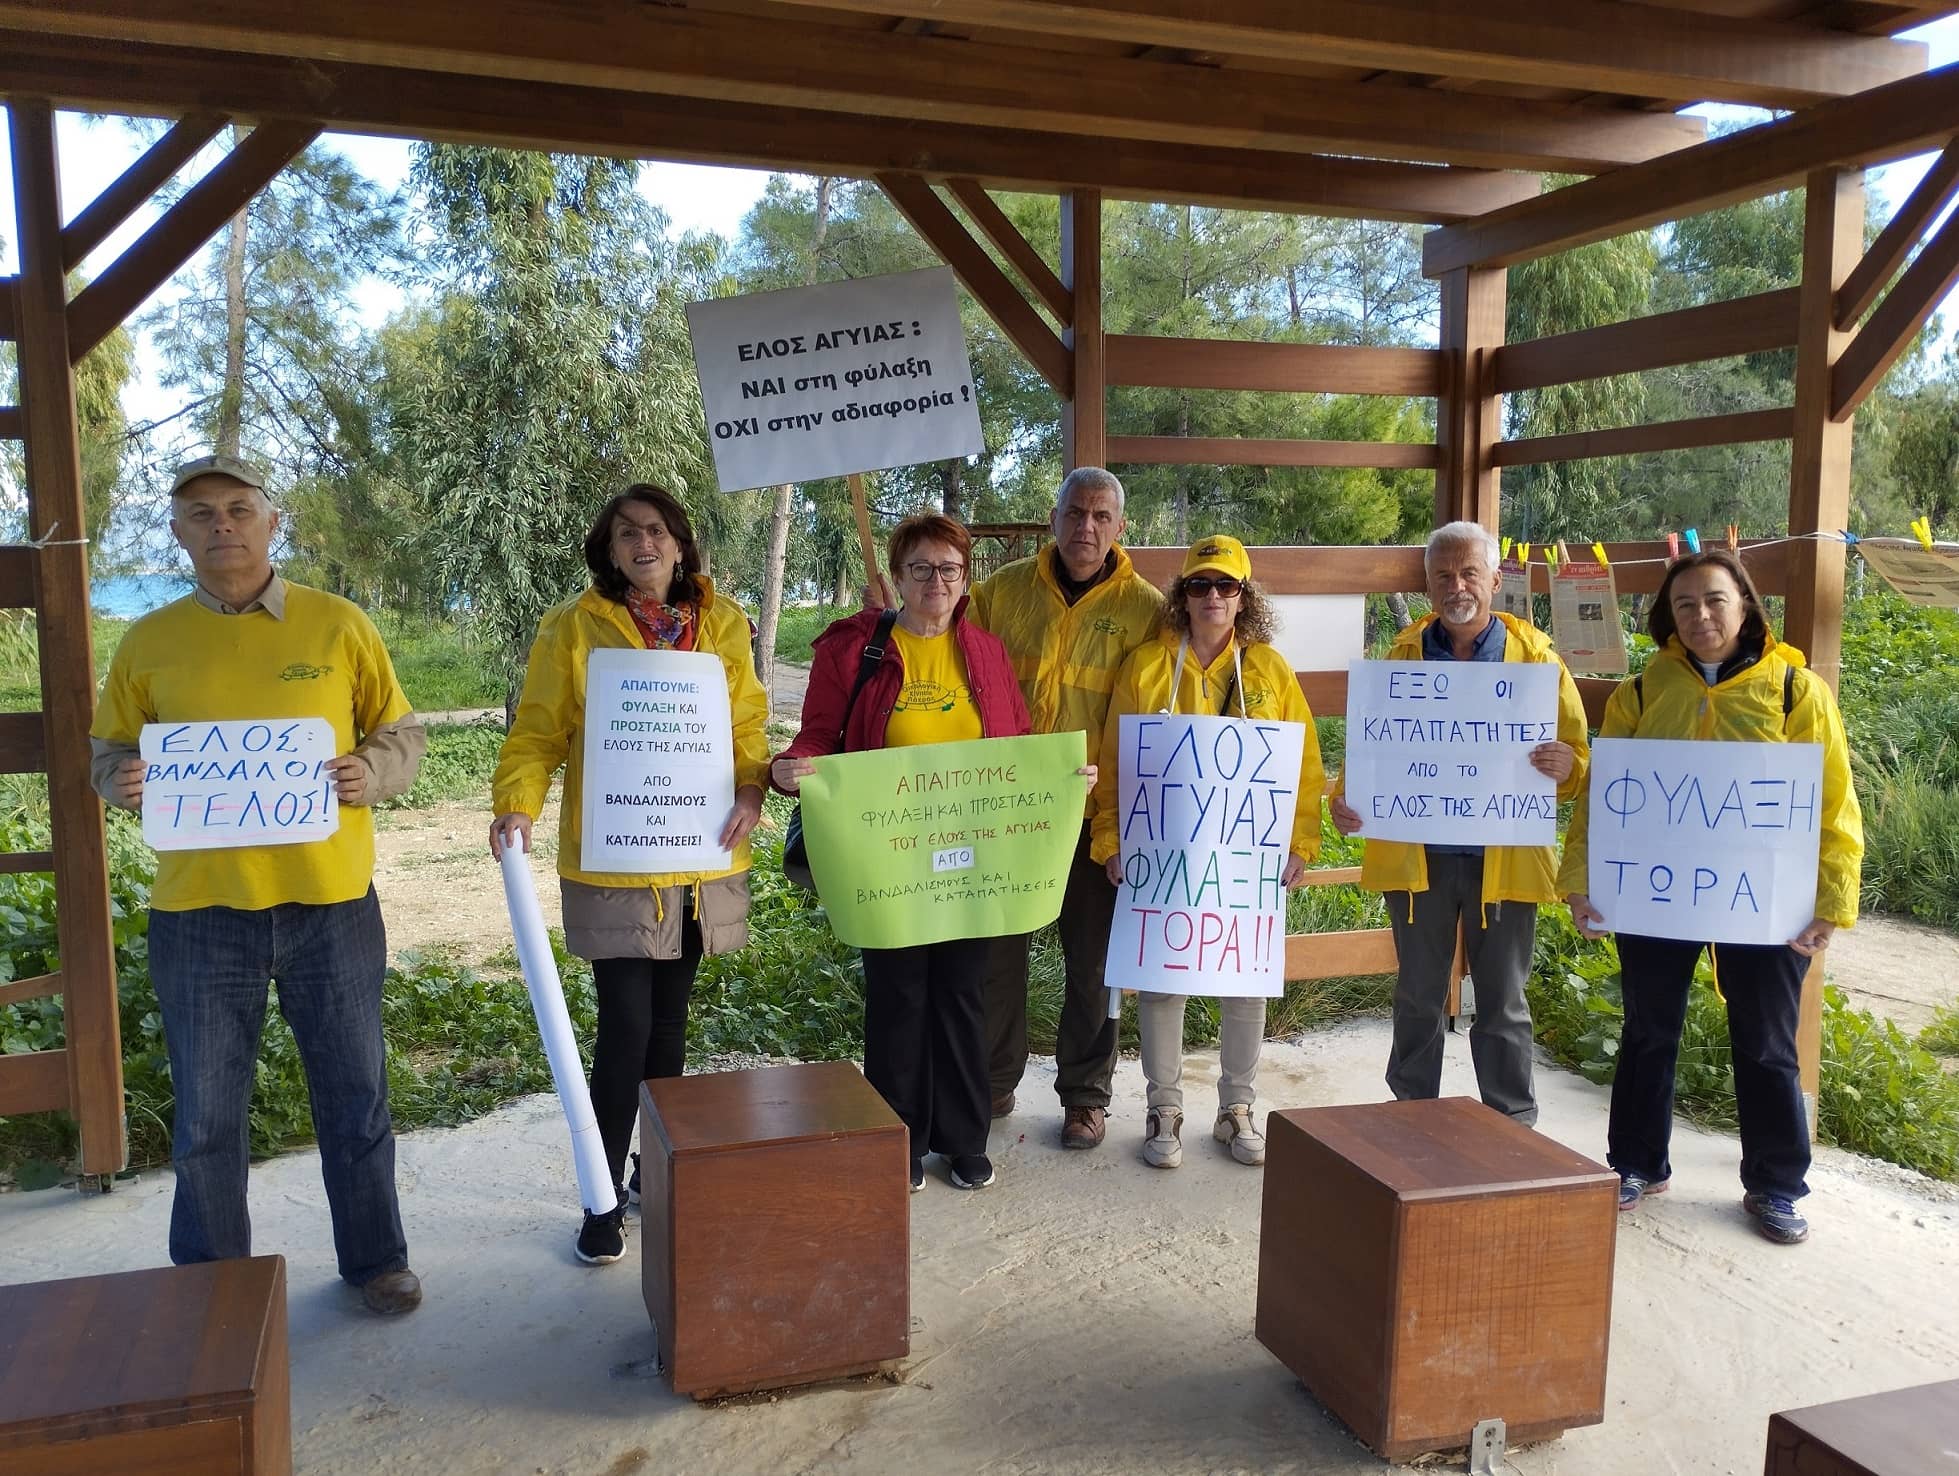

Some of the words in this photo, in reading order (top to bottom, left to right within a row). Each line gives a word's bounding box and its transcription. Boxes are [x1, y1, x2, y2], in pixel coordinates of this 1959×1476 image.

[738, 336, 807, 362] ΕΛΟΣ
[814, 321, 905, 351] ΑΓΥΙΑΣ
[741, 377, 786, 400] ΝΑΙ
[794, 372, 838, 392] στη
[844, 357, 932, 387] φύλαξη
[714, 417, 759, 439] ΟΧΙ
[767, 411, 823, 431] στην
[831, 390, 954, 422] αδιαφορία
[620, 679, 700, 694] ΑΠΑΙΤΟΥΜΕ:
[1389, 671, 1449, 700] ΕΞΩ
[1495, 680, 1513, 699] ΟΙ
[621, 701, 676, 713] ΦΥΛΑΞΗ
[679, 703, 697, 714] ΚΑΙ
[610, 720, 681, 733] ΠΡΟΣΤΑΣΙΑ
[684, 722, 707, 734] ΤΟΥ
[1364, 717, 1555, 743] ΚΑΤΑΠΑΤΗΤΕΣ
[604, 739, 644, 752] ΕΛΟΥΣ
[647, 741, 670, 753] ΤΗΣ
[673, 742, 712, 754] ΑΓΥΙΑΣ
[1136, 721, 1281, 785] ΕΛΟΣ
[145, 759, 323, 783] ΒΑΝΔΑΛΟΙ
[643, 775, 672, 787] ΑΠΟ
[896, 764, 1017, 796] ΑΠΑΙΤΟΥΜΕ
[1407, 762, 1438, 778] ΑΠΟ
[1456, 765, 1477, 777] ΤΟ
[163, 781, 330, 828] ΤΕΛΟΣ!
[605, 793, 707, 806] ΒΑΝΔΑΛΙΣΜΟΥΣ
[861, 805, 933, 829] ΦΥΛΑΞΗ
[938, 802, 963, 820] ΚΑΙ
[970, 791, 1055, 815] ΠΡΟΣΤΑΣΙΑ
[1372, 794, 1434, 819] ΕΛΟΣ
[1439, 796, 1475, 817] ΤΗΣ
[1604, 768, 1815, 833] ΦΥΛΑΞΗ
[646, 815, 666, 826] ΚΑΙ
[1124, 781, 1292, 848] ΑΓΥΙΑΣ
[606, 834, 702, 847] ΚΑΤΑΠΑΤΗΣΕΙΣ!
[889, 834, 918, 851] ΤΟΥ
[928, 830, 968, 846] ΕΛΟΥΣ
[972, 827, 997, 840] ΤΗΣ
[1005, 820, 1051, 836] ΑΓΥΙΑΣ
[937, 850, 970, 867] ΑΠΟ
[856, 876, 971, 905] ΒΑΝΔΑΛΙΣΜΟΥΣ
[982, 871, 1011, 883] ΚΑΙ
[934, 878, 1057, 904] ΚΑΤΑΠΑΤΗΣΕΙΣ
[1125, 847, 1282, 911] ΦΥΛΑΞΗ
[1605, 860, 1759, 913] ΤΩΡΑ
[1131, 907, 1274, 973] ΤΩΡΑ!!
